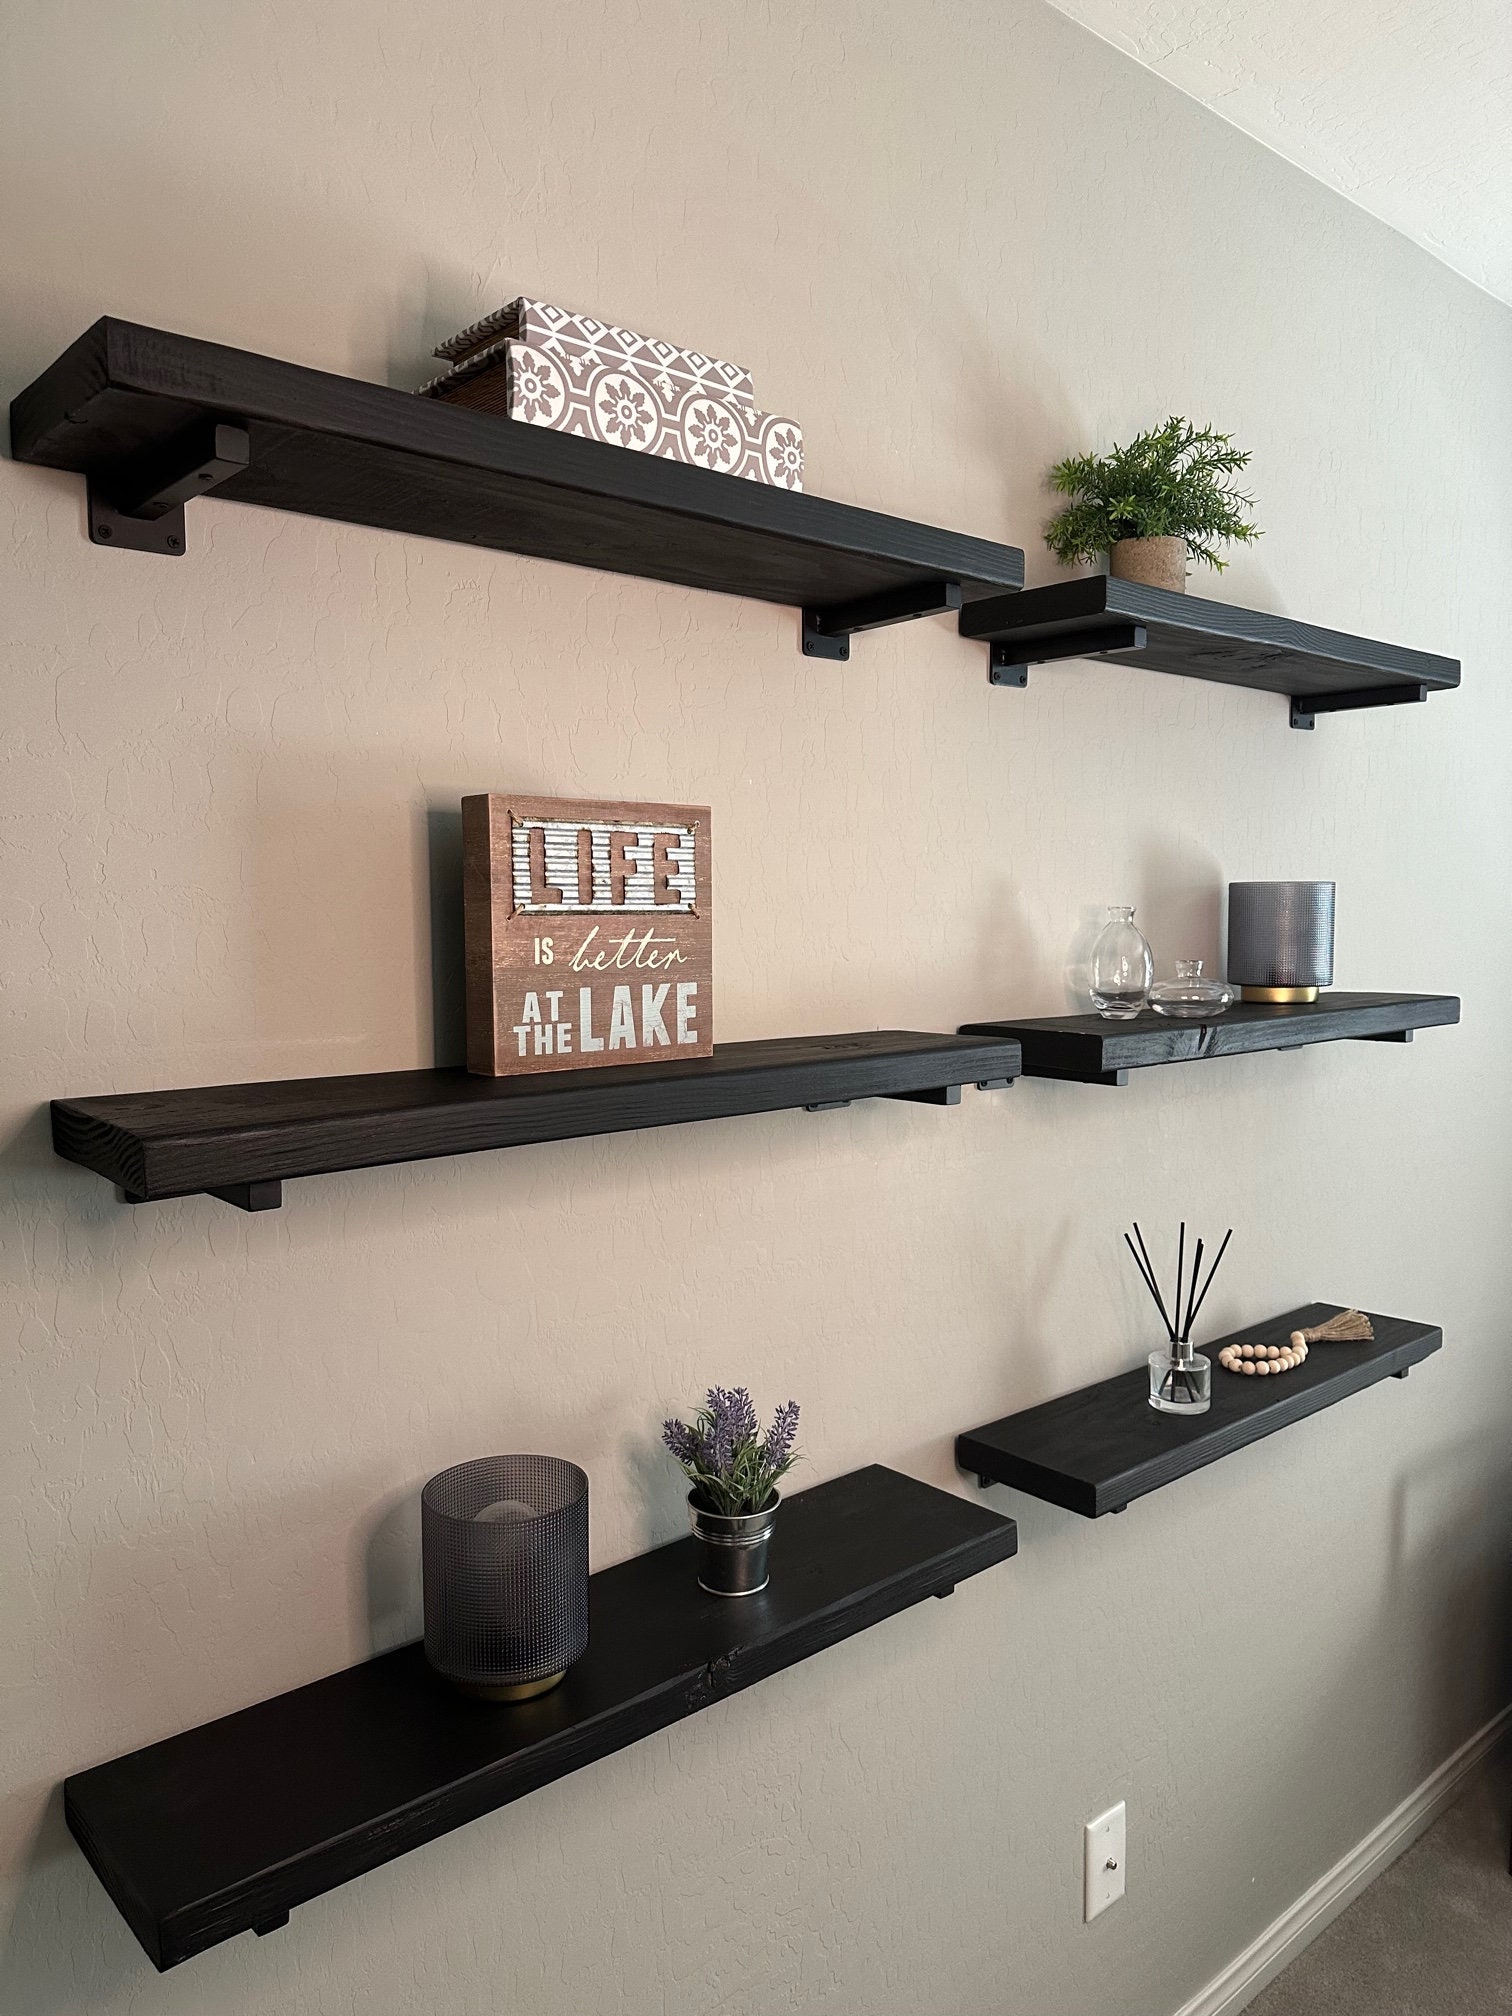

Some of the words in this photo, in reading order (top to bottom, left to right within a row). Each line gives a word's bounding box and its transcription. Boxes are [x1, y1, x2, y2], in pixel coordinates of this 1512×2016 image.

[529, 827, 681, 905] LIFE
[534, 937, 554, 965] IS
[569, 925, 688, 972] better
[522, 991, 563, 1023] AT
[579, 982, 698, 1052] LAKE
[513, 1023, 572, 1057] THE
